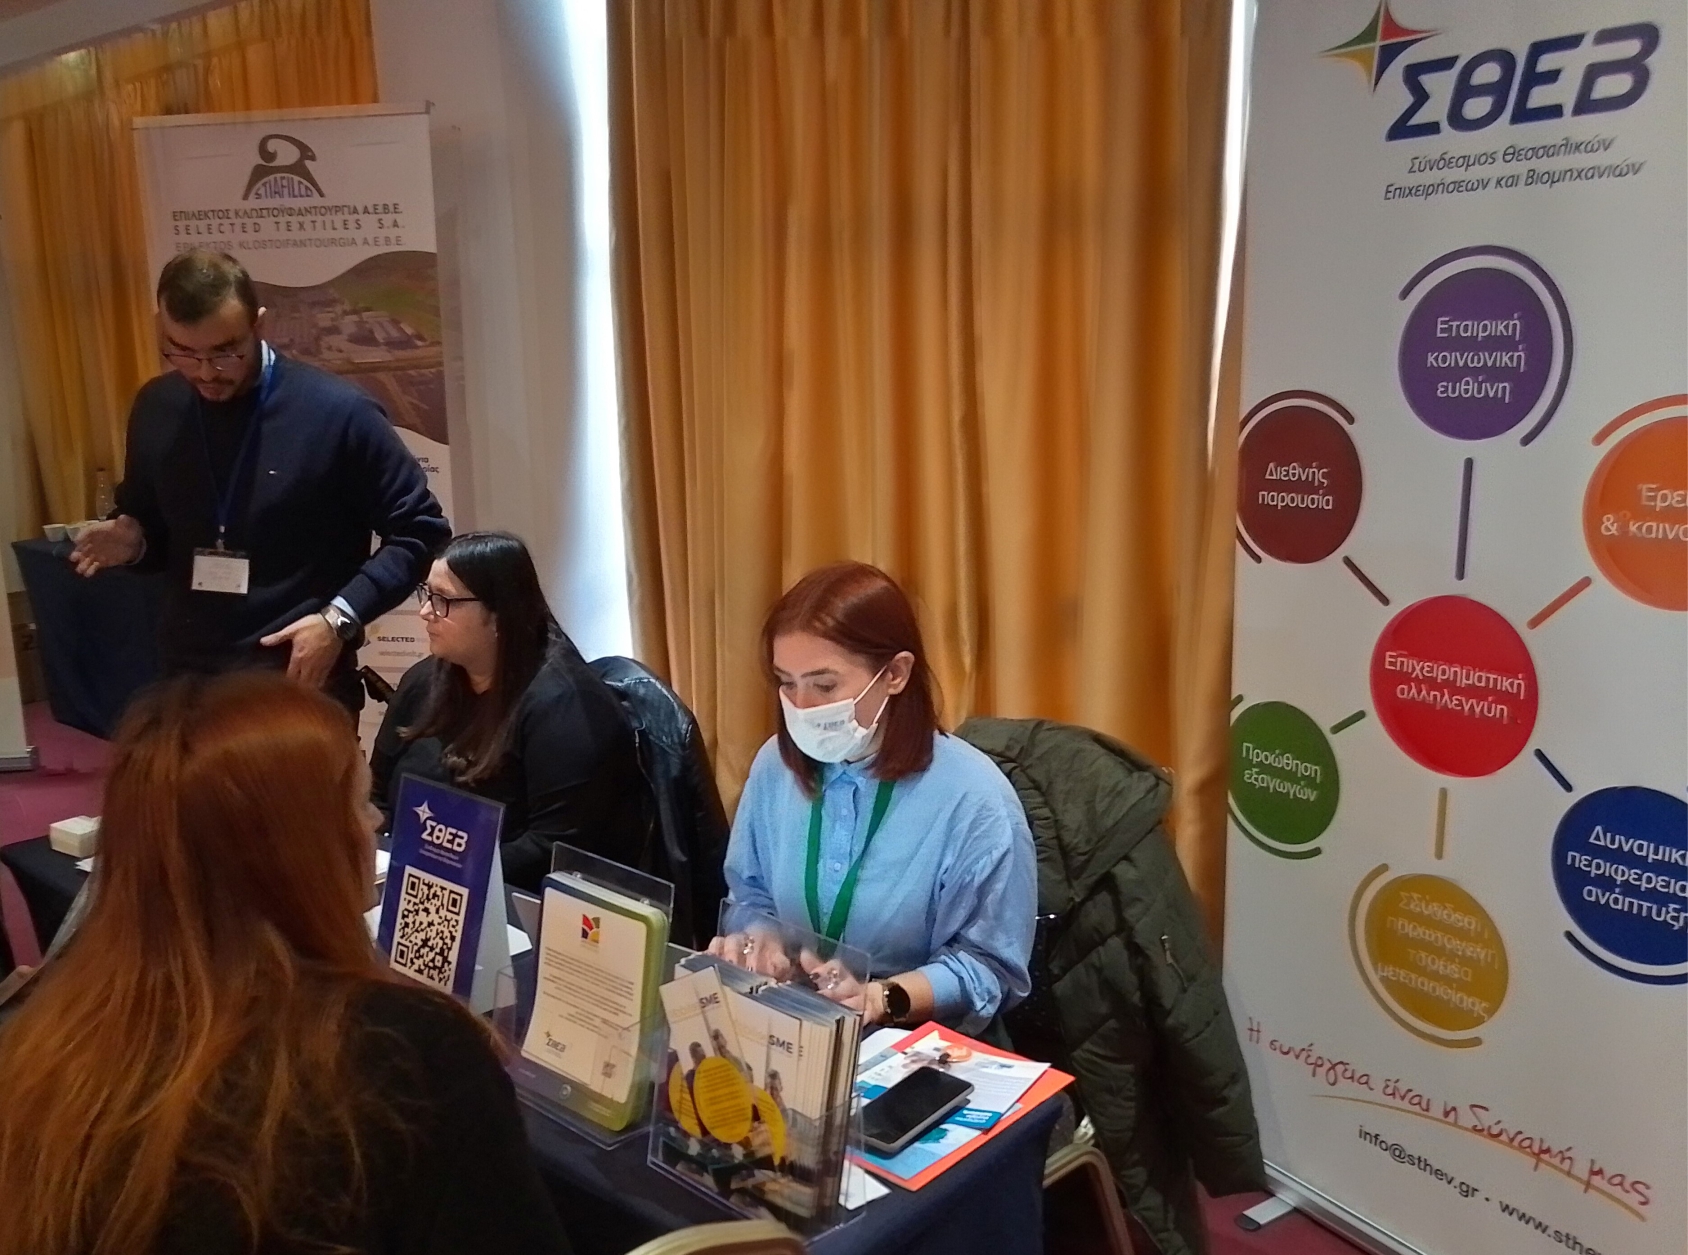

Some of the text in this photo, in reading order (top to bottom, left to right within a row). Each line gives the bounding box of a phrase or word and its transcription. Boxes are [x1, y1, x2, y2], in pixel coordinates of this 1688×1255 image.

[1385, 21, 1660, 142] ΣΘΕΒ
[1408, 135, 1617, 174] Σύνδεσμος Θεσσαλικών
[1384, 159, 1647, 201] Επιχειρήσεων και Βιομηχανιών
[172, 208, 232, 221] ΕΠΙΛΕΚΤΟΣ
[173, 217, 405, 235] SELECTED TEXTILES S.A.
[1436, 312, 1521, 341] Εταιρική
[1427, 344, 1526, 372] κοινωνική
[1436, 375, 1511, 404] ευθύνη
[1264, 462, 1329, 487] Διεθνής
[1258, 490, 1333, 510] παρουσία
[1637, 483, 1688, 511] Έρε
[1600, 513, 1619, 536] &
[1384, 651, 1526, 700] Επιχειρηματική
[1396, 682, 1509, 724] αλληλεγγύη
[1242, 742, 1321, 784] Προώθηση
[1243, 767, 1318, 802] εξαγωγών
[421, 819, 468, 853] ΣΘΕΒ
[1588, 825, 1688, 867] Δυναμικ
[1357, 1125, 1607, 1255] info@sthev.gr www.sthe
